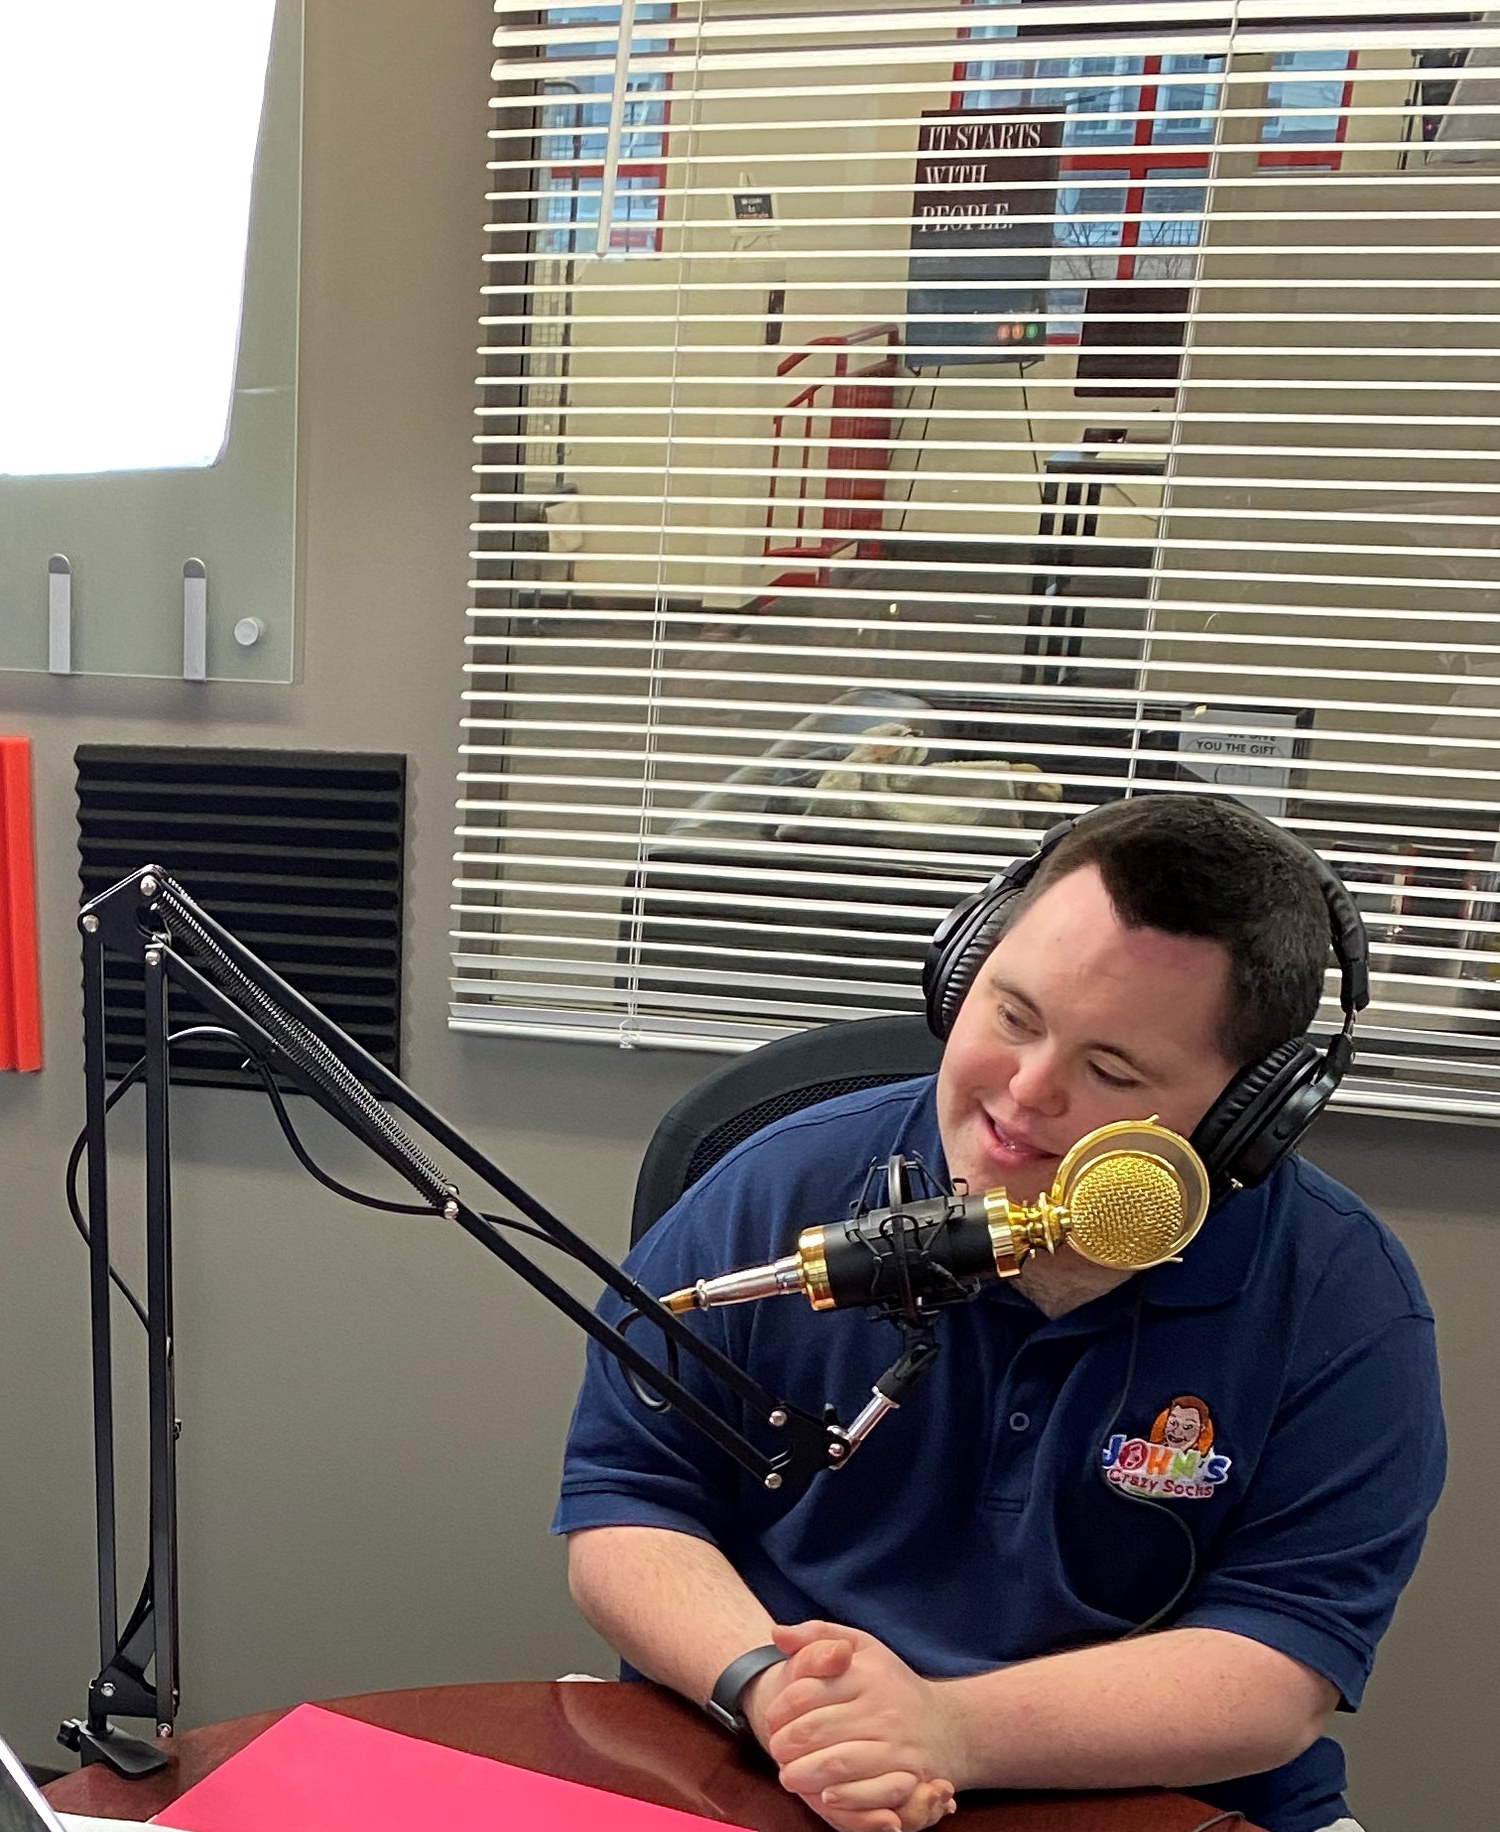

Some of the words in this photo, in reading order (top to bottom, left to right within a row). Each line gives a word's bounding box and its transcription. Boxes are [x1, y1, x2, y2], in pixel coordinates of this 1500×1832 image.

[928, 126, 951, 151] IT
[955, 124, 1041, 150] STARTS
[925, 164, 987, 185] WITH
[1197, 741, 1222, 751] YOU
[1225, 743, 1246, 753] THE
[1250, 744, 1276, 755] GIFT
